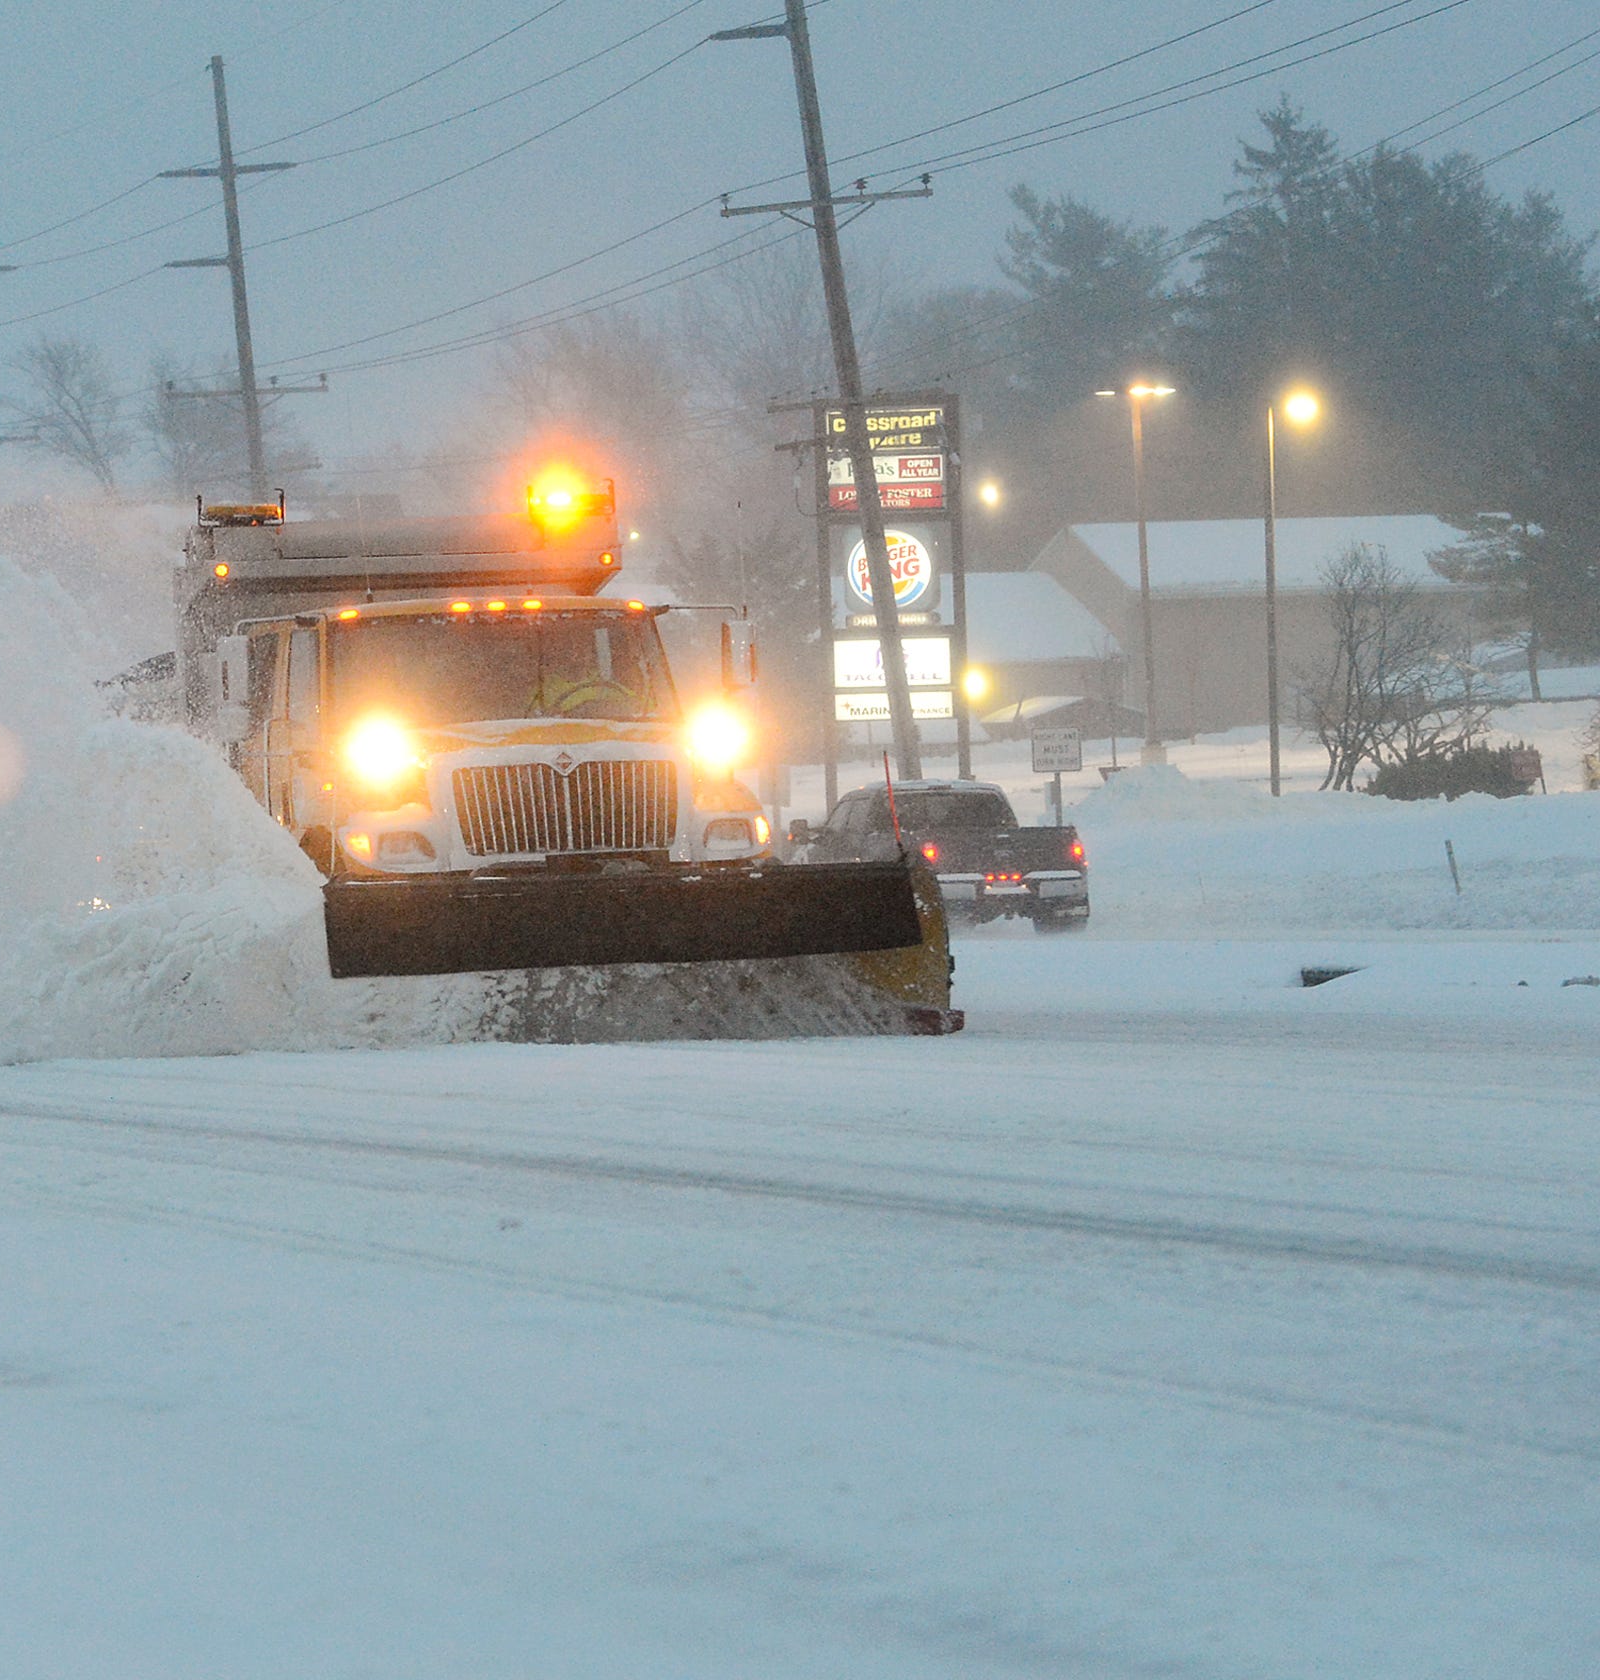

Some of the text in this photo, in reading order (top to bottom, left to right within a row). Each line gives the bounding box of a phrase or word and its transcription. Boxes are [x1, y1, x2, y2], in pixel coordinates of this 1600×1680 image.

[833, 411, 937, 432] cssroad
[907, 459, 934, 468] OPEN
[901, 467, 939, 477] ALL YEAR
[887, 487, 933, 499] FOSTER
[880, 498, 911, 508] LTORS
[858, 545, 917, 572] BGER
[861, 558, 920, 591] KNG
[850, 706, 892, 716] MARIN
